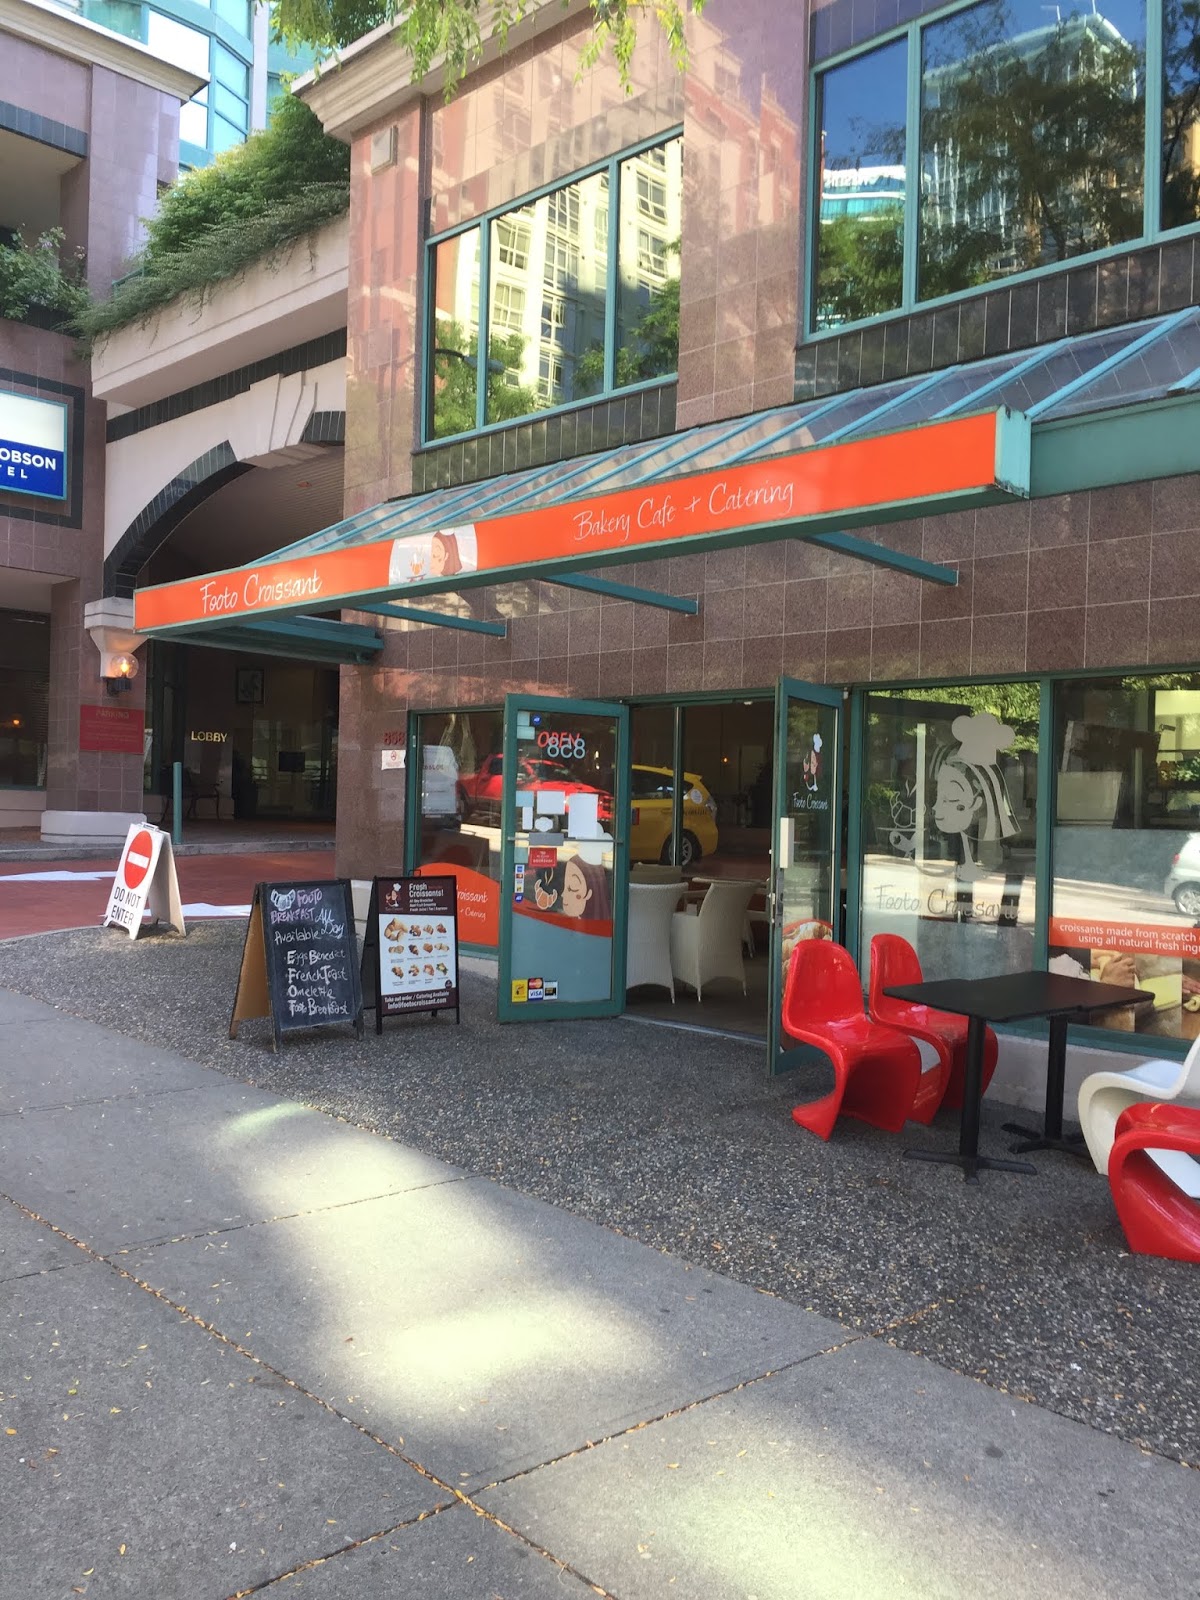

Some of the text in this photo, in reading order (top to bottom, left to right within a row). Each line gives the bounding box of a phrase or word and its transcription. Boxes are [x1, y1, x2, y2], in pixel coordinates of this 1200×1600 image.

[0, 464, 28, 479] EL
[572, 481, 794, 542] Bakery Cafe + Catering
[200, 568, 323, 614] Footo Croissant
[191, 731, 228, 743] LOBBY
[537, 731, 581, 749] OPEN
[409, 882, 428, 891] Fresh
[409, 889, 444, 898] Croissants!
[456, 885, 489, 904] roissant
[113, 886, 142, 908] DO NOT
[873, 884, 920, 911] Footo
[110, 904, 135, 926] ENTER
[270, 907, 316, 925] BREAKFAST
[1060, 923, 1197, 942] croissants made from scratch
[1078, 934, 1103, 947] using
[1106, 936, 1116, 945] all
[1119, 938, 1153, 948] natural
[1155, 940, 1180, 951] fresh
[287, 965, 348, 985] French Toast
